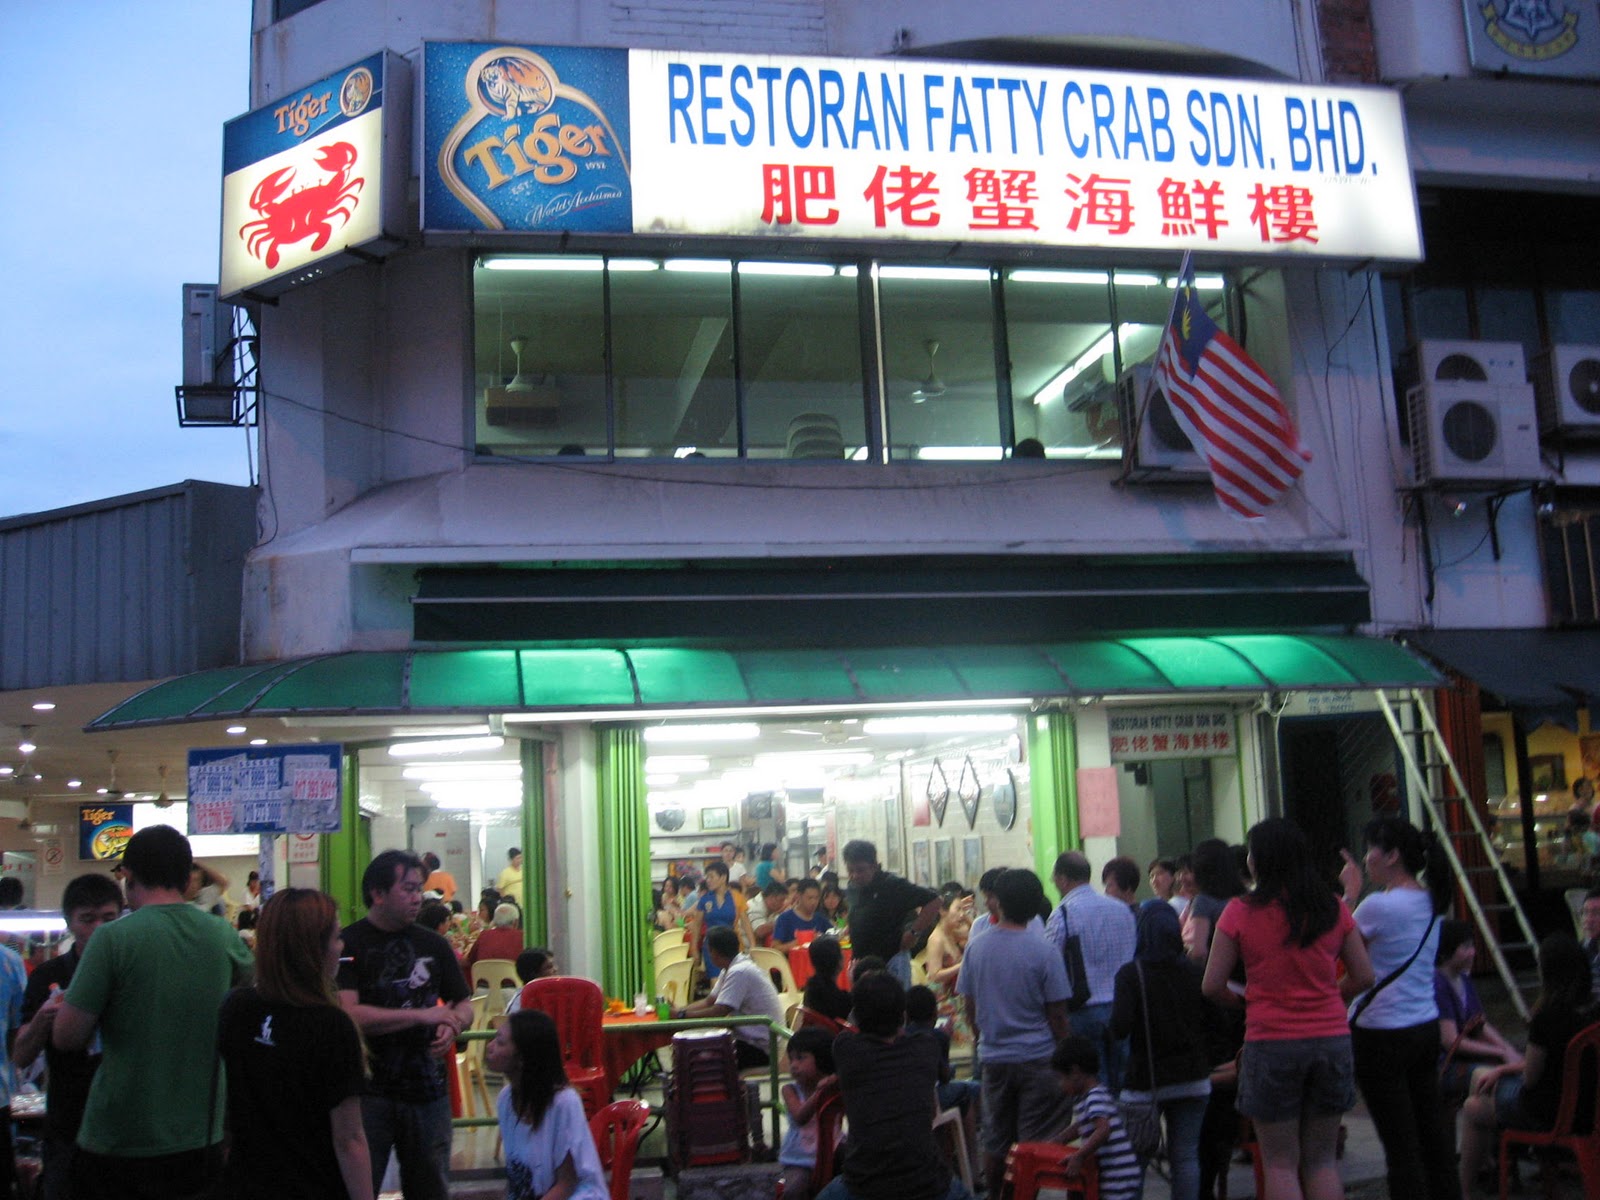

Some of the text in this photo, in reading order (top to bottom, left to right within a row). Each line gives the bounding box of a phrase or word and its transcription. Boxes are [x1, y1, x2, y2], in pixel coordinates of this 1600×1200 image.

[274, 91, 333, 136] Tiger
[463, 113, 611, 191] Tiger
[667, 62, 1378, 177] RESTORAN FATTY CRAB SDN. BHD.
[760, 163, 1320, 245] 肥佬蟹海鮮樓
[82, 808, 116, 826] Tiger
